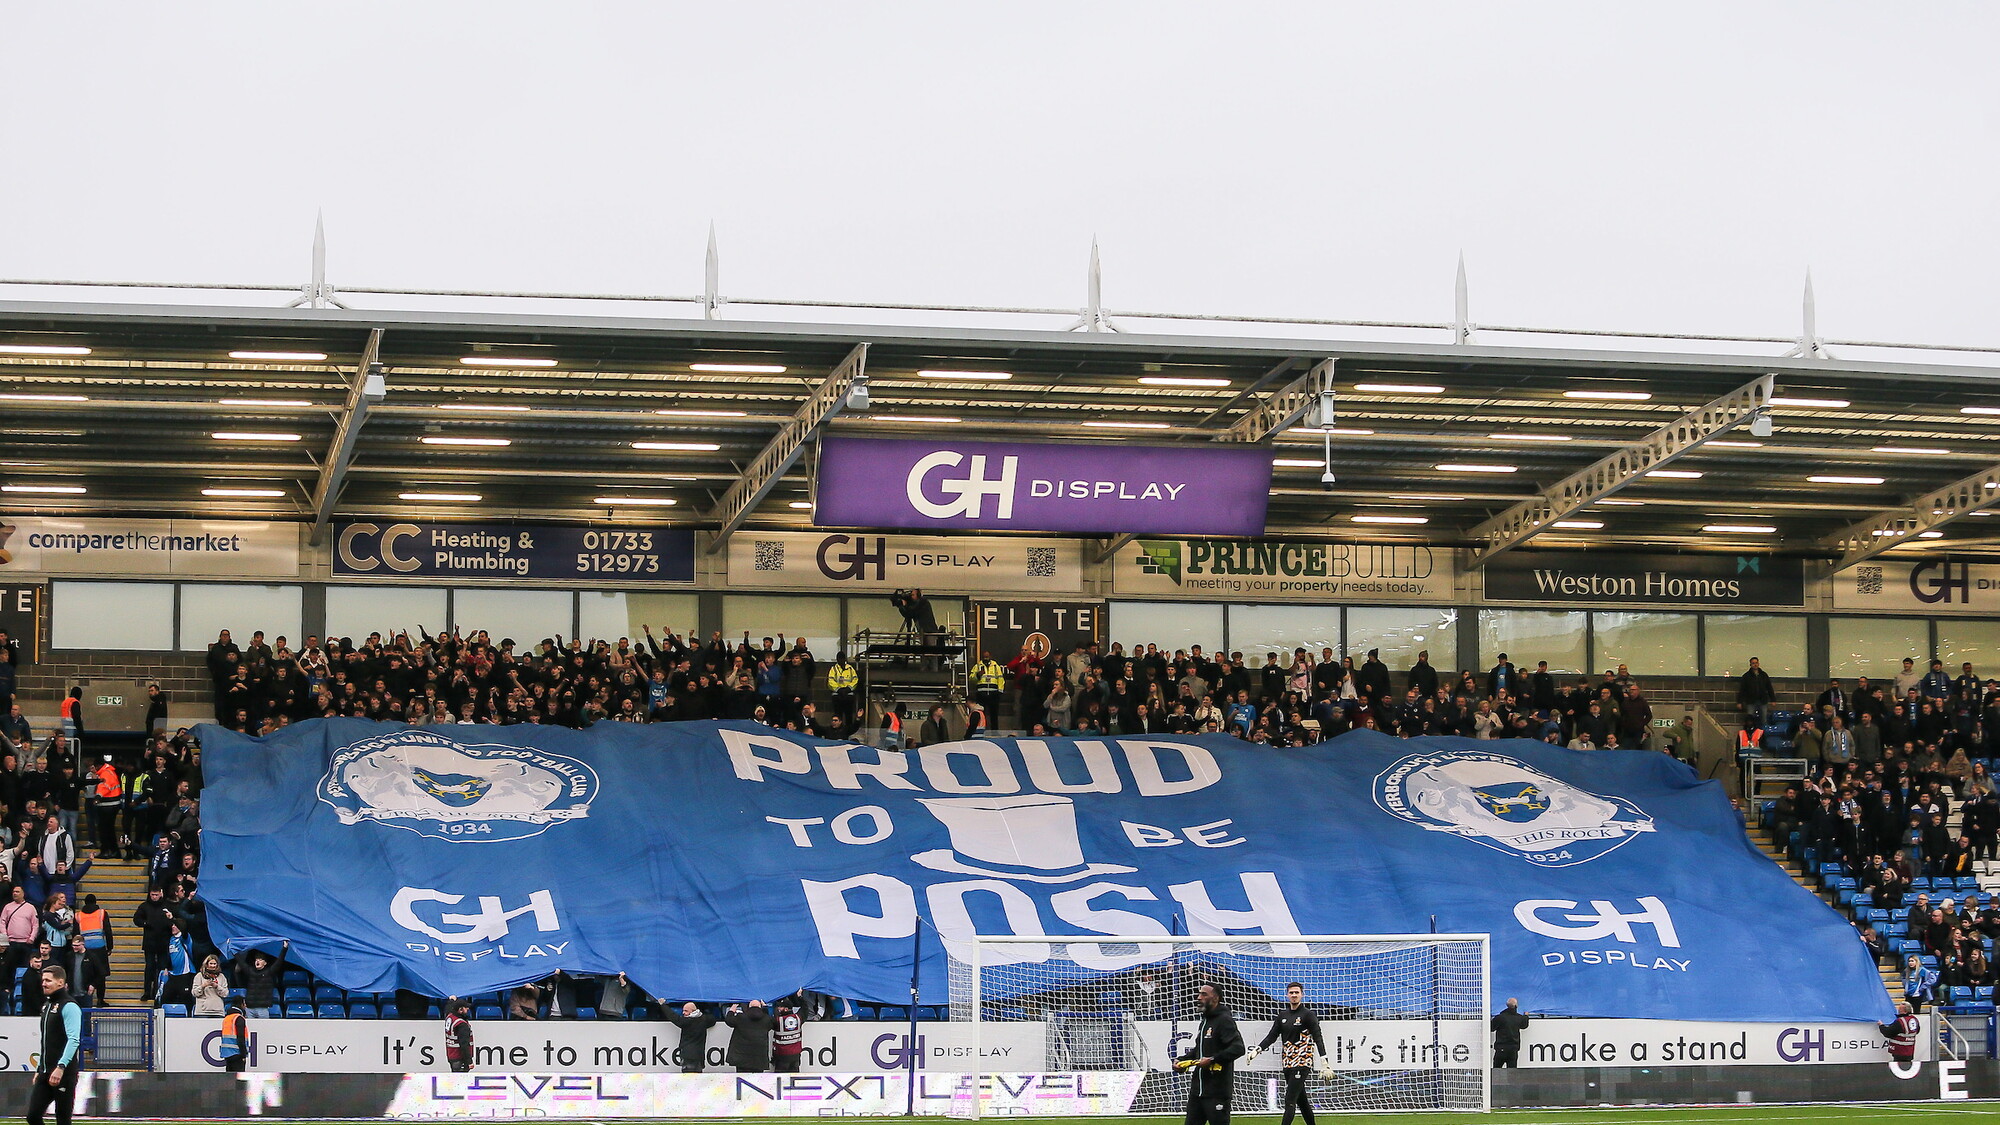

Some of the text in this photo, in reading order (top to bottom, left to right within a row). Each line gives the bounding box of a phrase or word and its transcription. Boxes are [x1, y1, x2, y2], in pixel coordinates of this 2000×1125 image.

[907, 451, 1187, 519] GH DISPLAY
[29, 532, 239, 553] comparethemarket
[338, 522, 422, 572] CC
[431, 530, 534, 553] Heating &
[583, 531, 653, 551] 01733
[435, 551, 530, 575] Plumbing
[577, 553, 660, 573] 512973
[816, 535, 996, 581] GH DISPLAY
[1186, 577, 1434, 595] meeting your property needs today...
[1534, 568, 1741, 598] Weston Homes
[1910, 560, 1969, 604] GH
[984, 607, 1091, 631] ELITE
[719, 728, 1222, 797] PROUD
[569, 774, 588, 798] CLUB
[438, 823, 492, 835] 1934
[766, 805, 1248, 848] TO BE
[1514, 829, 1613, 844] THIS ROCK
[1522, 849, 1573, 862] 1934
[390, 886, 560, 944] GH
[801, 871, 1310, 970] POSH
[1513, 896, 1681, 948] GH
[405, 940, 570, 962] DISPLAY
[1542, 950, 1692, 972] DISPLAY
[266, 1043, 348, 1056] DISPLAY
[383, 1036, 435, 1066] It's
[543, 1040, 578, 1066] to
[871, 1033, 925, 1069] GH
[1336, 1035, 1470, 1064] It's time
[1529, 1032, 1747, 1062] make a stand
[1776, 1027, 1890, 1062] GH DISPLA
[432, 1076, 629, 1100] LEVEL
[736, 1076, 1109, 1100] NEXT LEVEL
